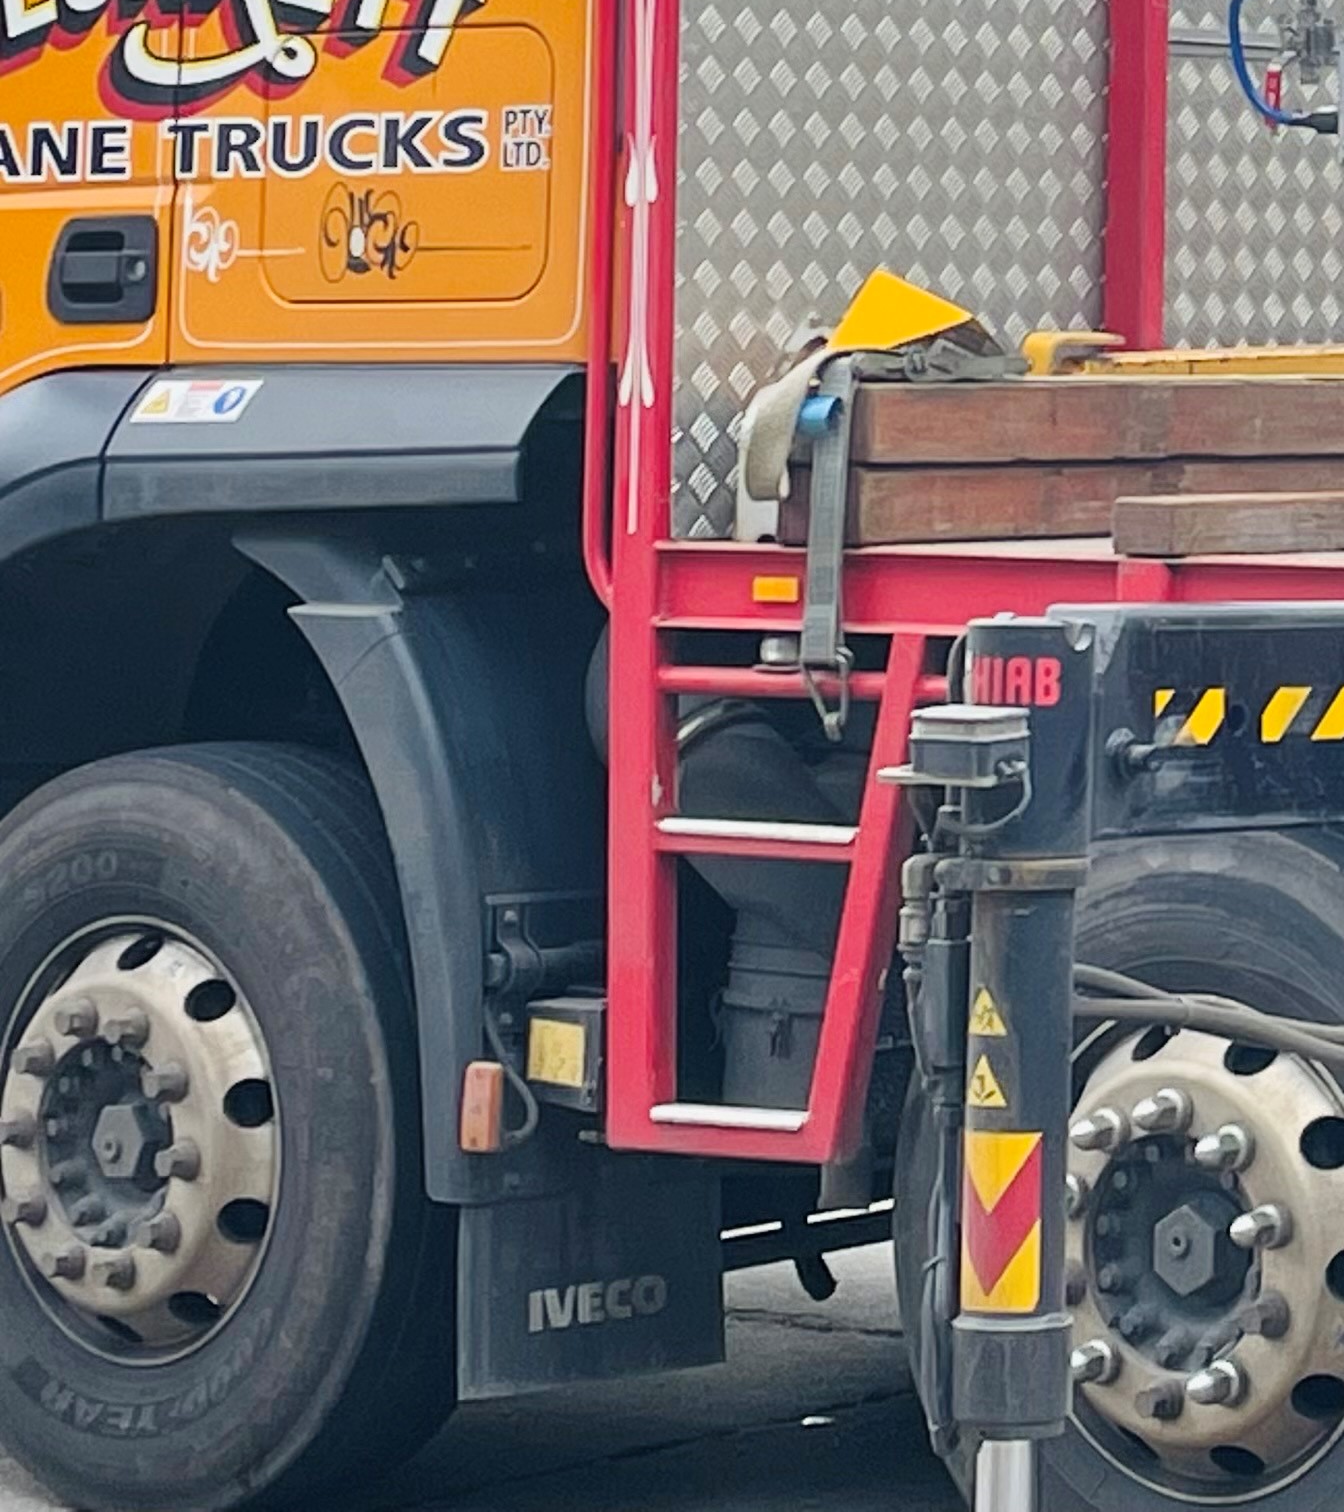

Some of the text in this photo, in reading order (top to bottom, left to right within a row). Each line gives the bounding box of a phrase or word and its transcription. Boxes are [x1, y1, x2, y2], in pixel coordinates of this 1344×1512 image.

[167, 111, 487, 179] TRUCKS
[972, 656, 1062, 707] HIAB
[527, 1273, 667, 1332] IVECO
